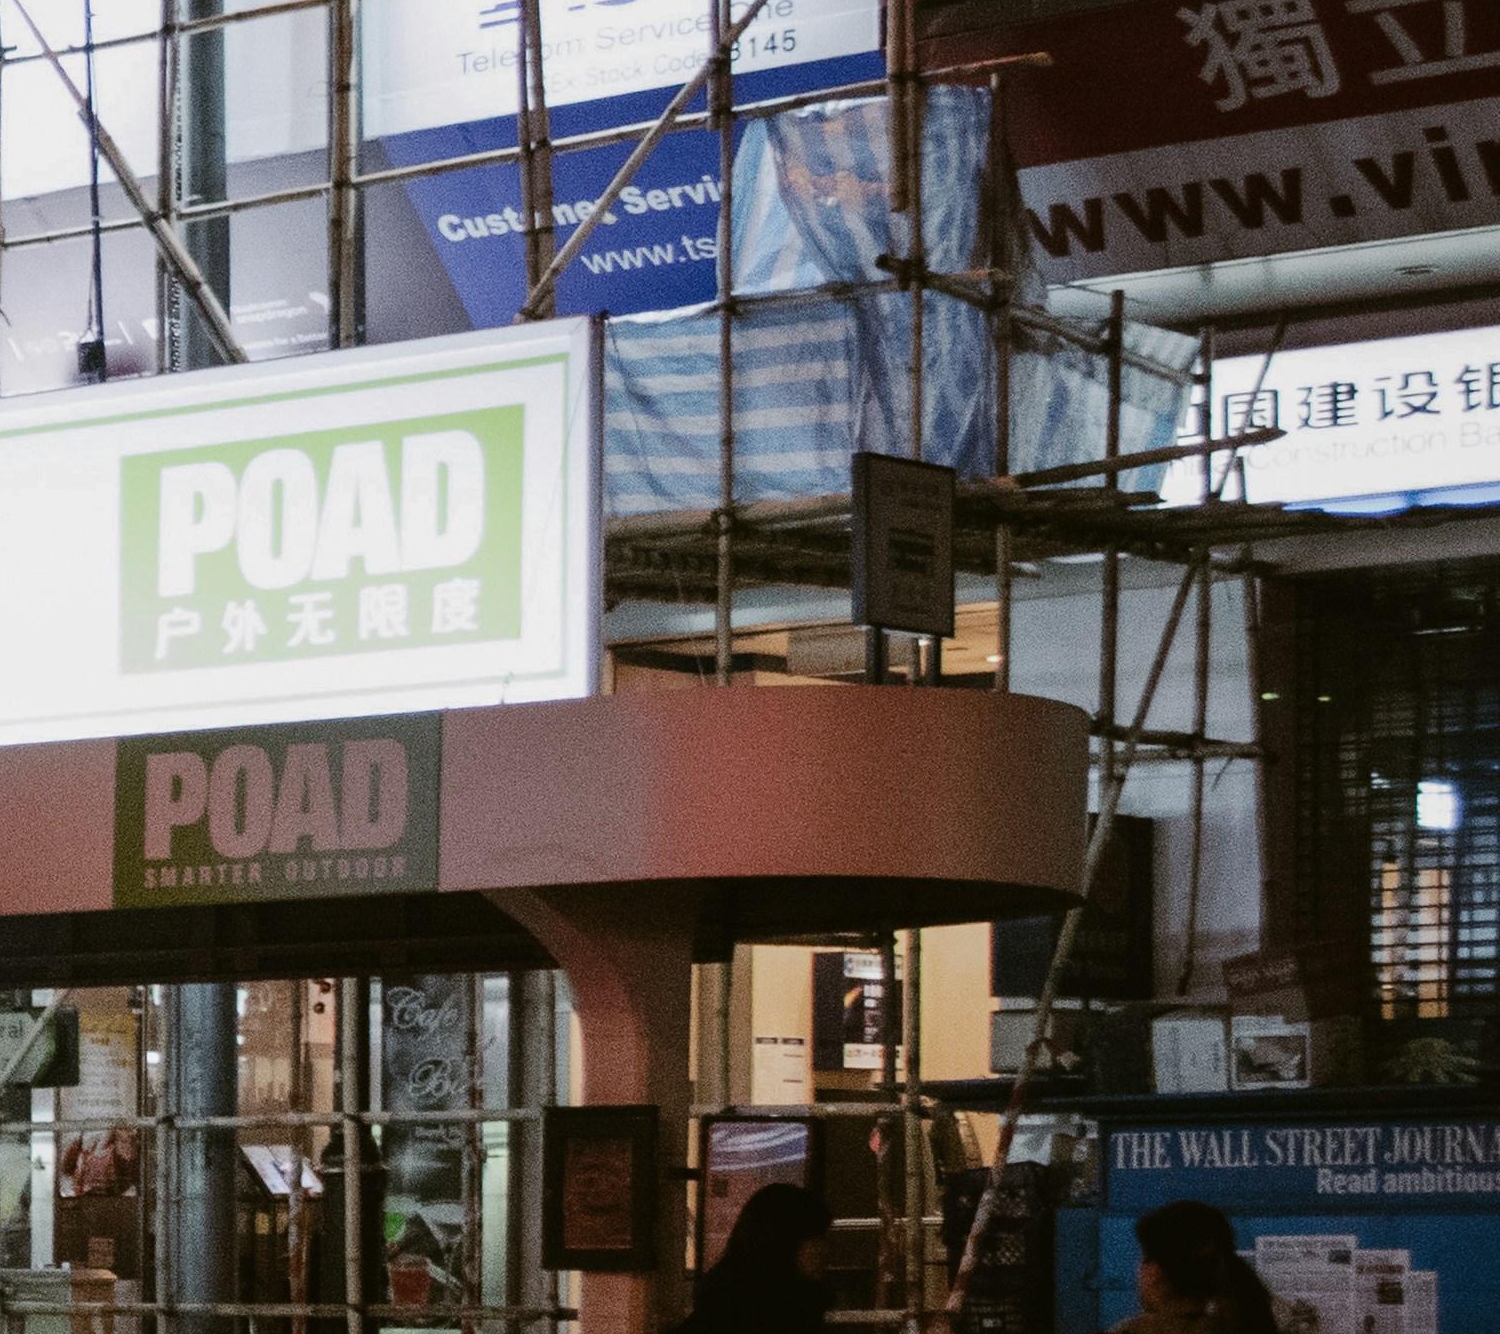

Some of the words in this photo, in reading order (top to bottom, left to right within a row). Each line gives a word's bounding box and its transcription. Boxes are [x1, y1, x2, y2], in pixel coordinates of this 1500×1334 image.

[597, 14, 712, 50] Service
[587, 61, 645, 88] Stock
[157, 430, 485, 597] POAD
[155, 580, 481, 661] 户外无限度
[145, 739, 408, 861] POAD
[143, 862, 262, 890] SMARTER
[286, 854, 407, 883] OUTDOOR
[1110, 1131, 1171, 1169] THE
[1178, 1129, 1259, 1168] WALL
[1266, 1126, 1381, 1167] STREET
[1317, 1168, 1378, 1195] Read
